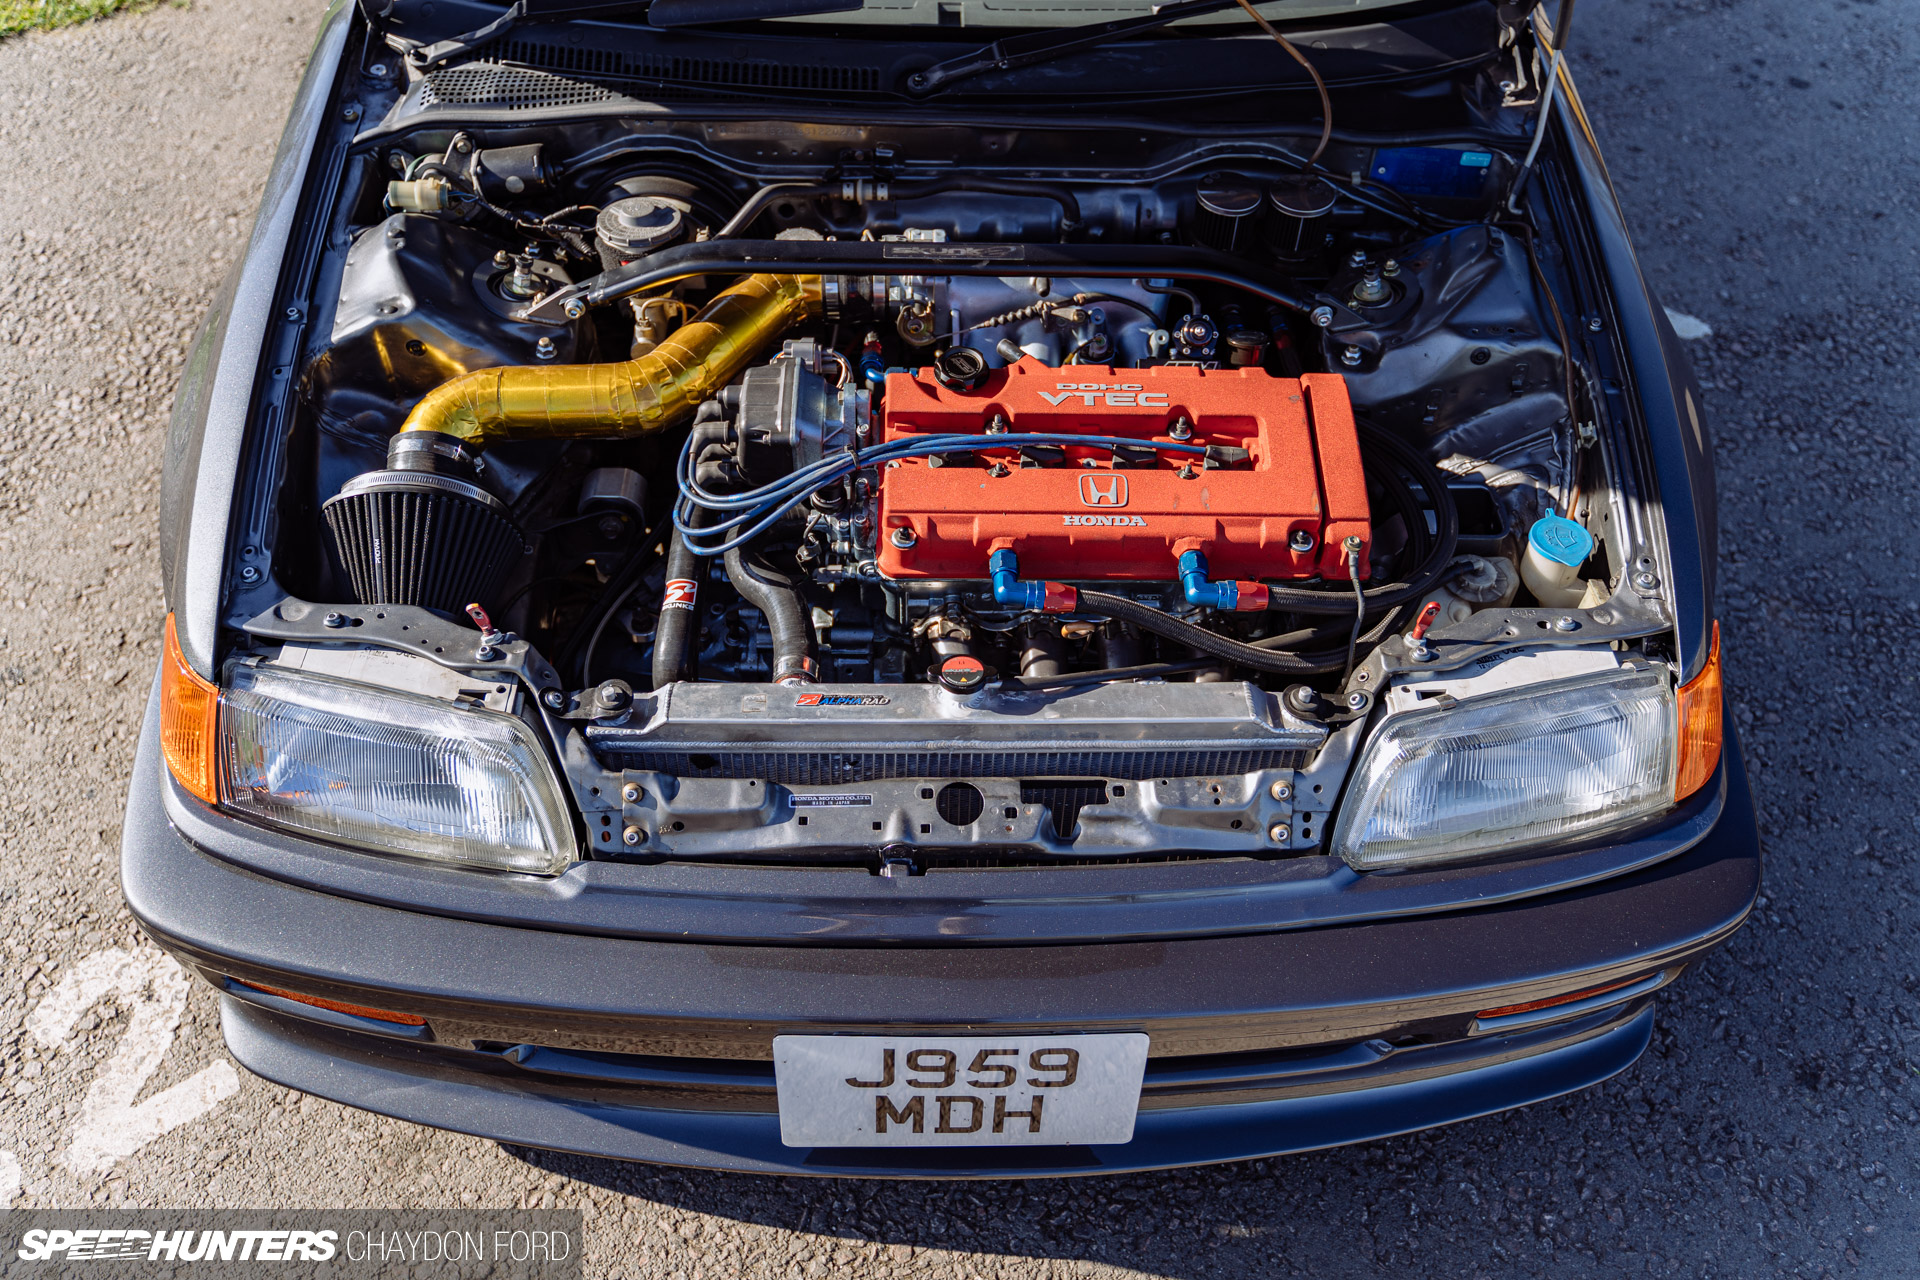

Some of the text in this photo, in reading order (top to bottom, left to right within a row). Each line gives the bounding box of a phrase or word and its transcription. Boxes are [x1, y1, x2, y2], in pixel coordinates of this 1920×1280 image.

[1056, 383, 1143, 391] DOHC
[1037, 391, 1169, 407] VTEC
[1063, 515, 1147, 526] HONDA
[819, 697, 890, 705] ALPHARAD
[845, 1048, 1080, 1089] J959
[875, 1094, 1044, 1134] MDH
